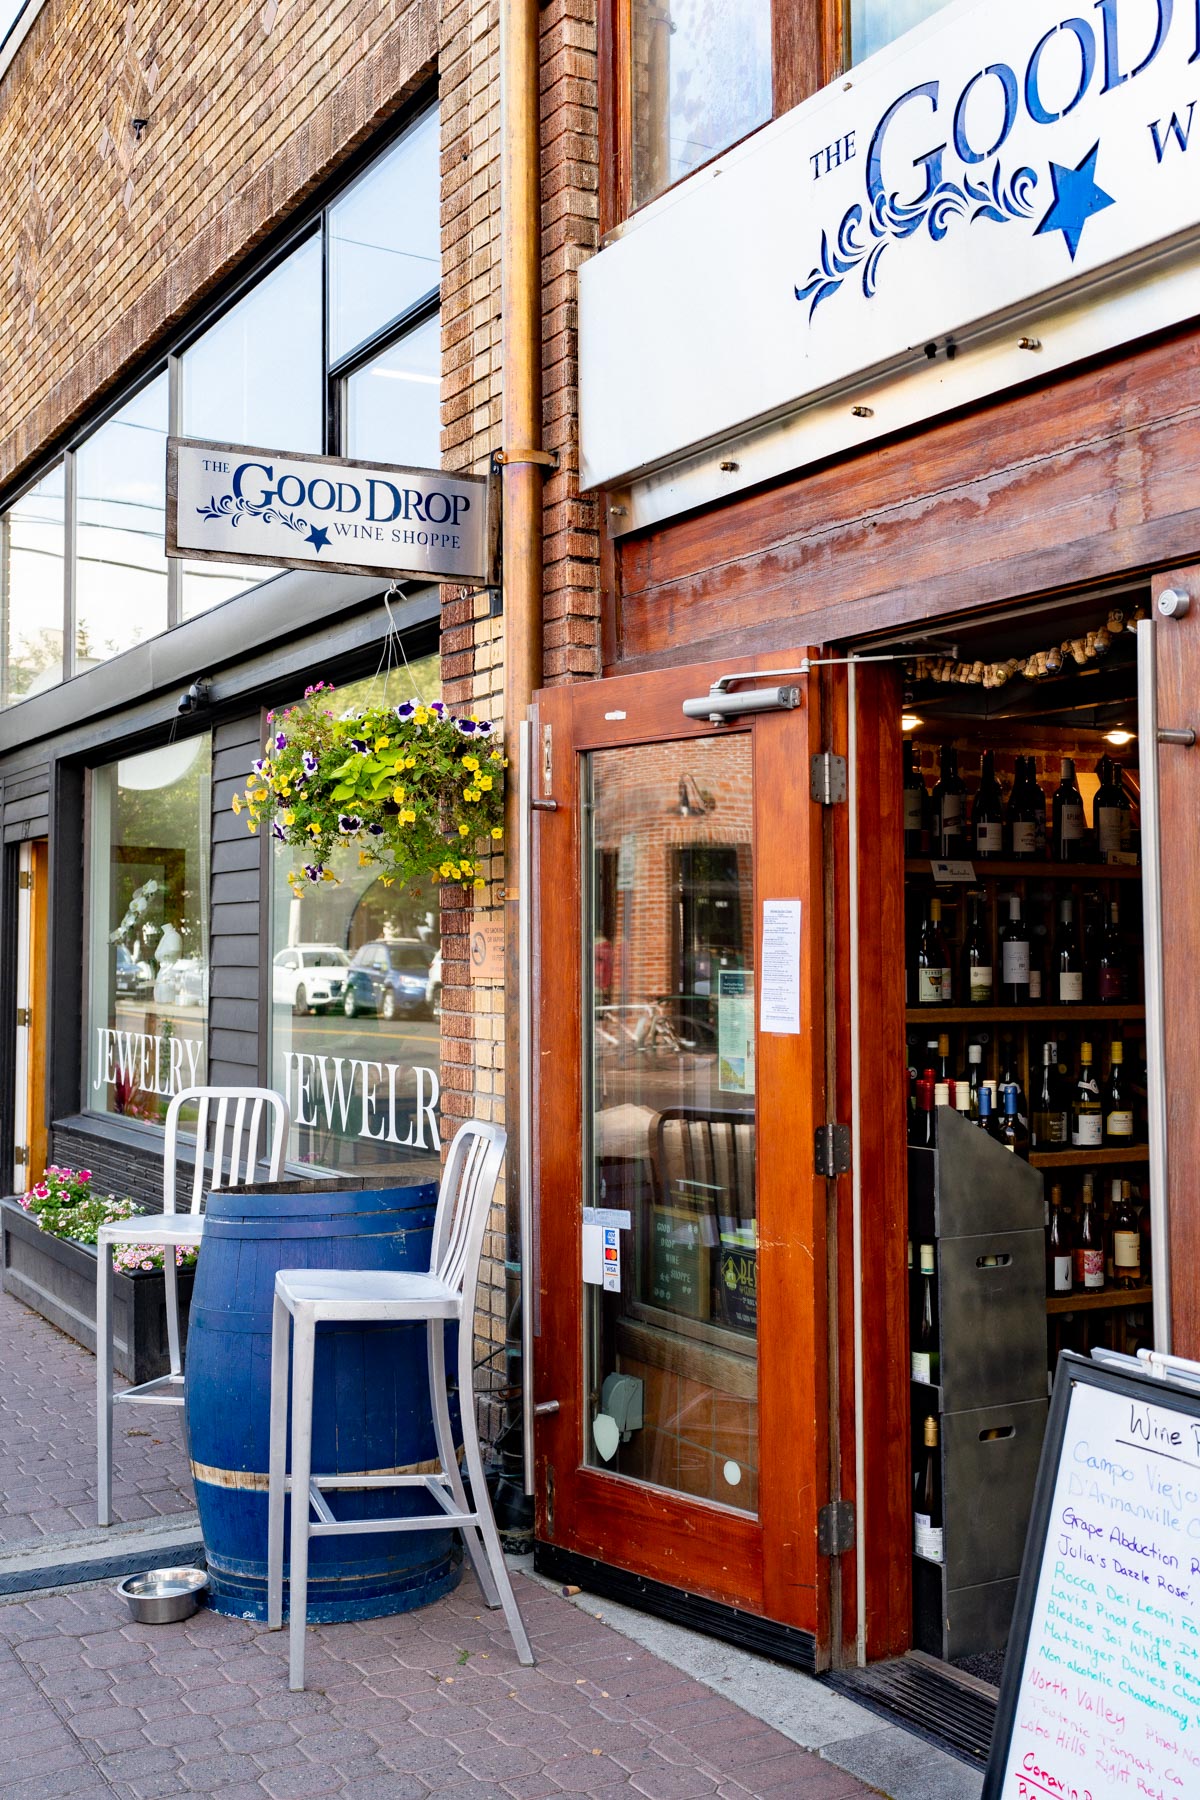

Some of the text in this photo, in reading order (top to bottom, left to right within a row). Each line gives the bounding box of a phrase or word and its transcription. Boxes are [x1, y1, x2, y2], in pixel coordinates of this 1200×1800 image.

[810, 130, 856, 181] THE
[202, 459, 471, 526] THE GOOD DROP
[333, 522, 461, 549] WINE SHOPPE
[93, 1027, 203, 1101] JEWELRY
[283, 1051, 441, 1151] JEWELR
[605, 1265, 617, 1273] VISA
[665, 1252, 680, 1265] WINE
[1130, 1404, 1182, 1445] Wine
[1073, 1440, 1134, 1487] Campo
[1058, 1533, 1106, 1568] Julia's
[1112, 1558, 1150, 1585] Dazzle
[1062, 1507, 1103, 1540] Grape
[1109, 1526, 1178, 1569] Abduction
[1096, 1602, 1127, 1628] Pinot
[1173, 1660, 1200, 1686] Blen
[1028, 1667, 1068, 1700] North
[1077, 1686, 1125, 1735] Valley
[1055, 1729, 1086, 1756] Hills
